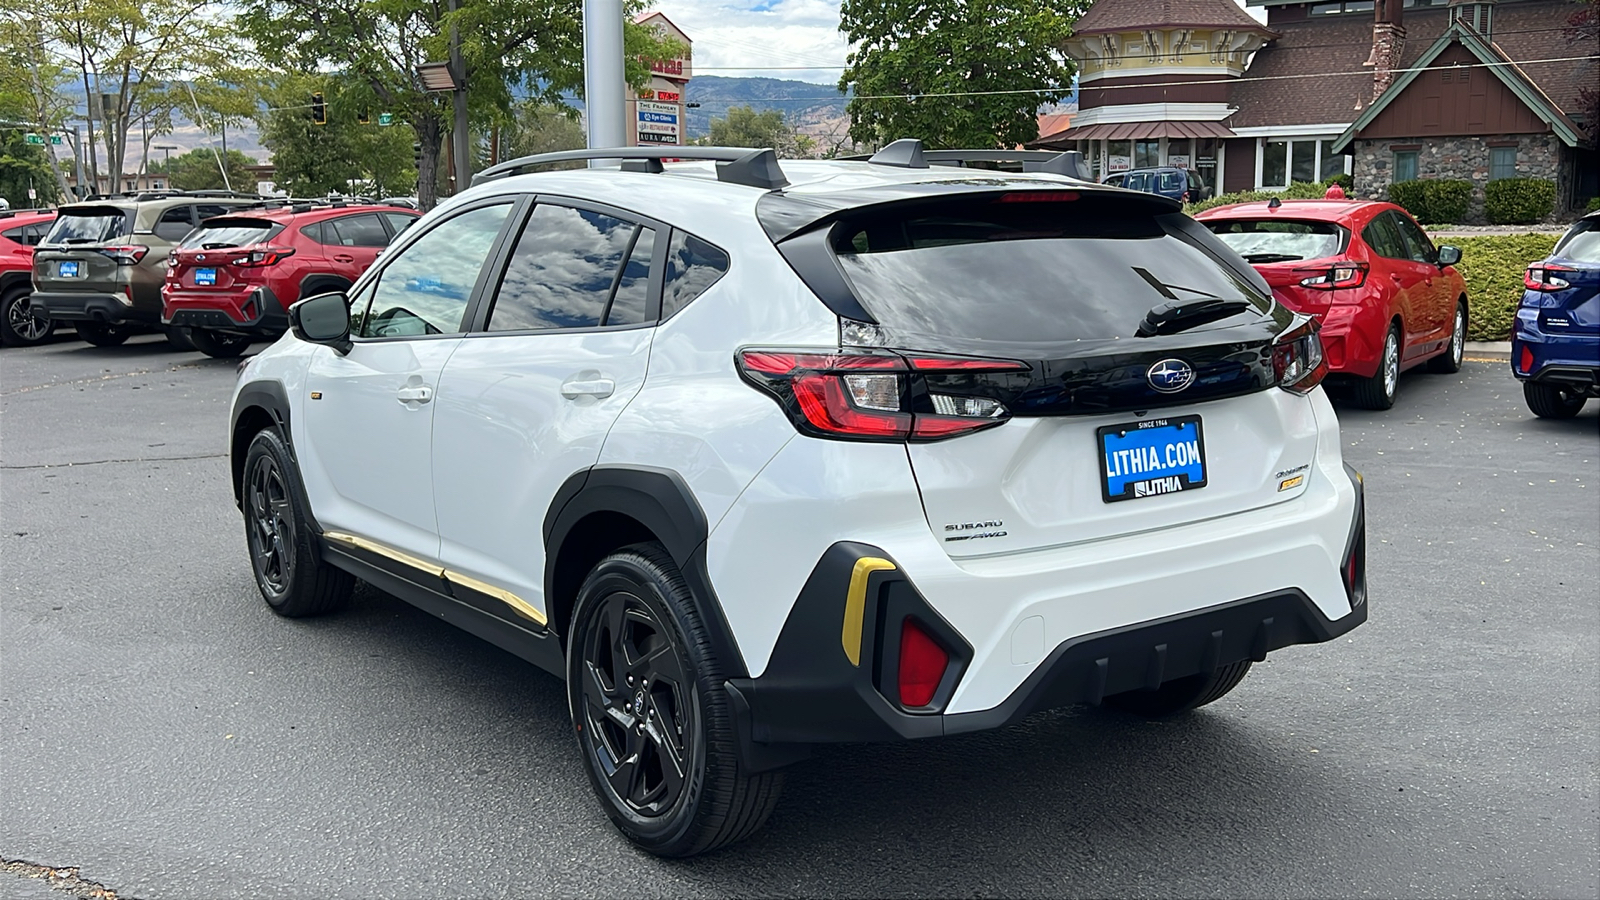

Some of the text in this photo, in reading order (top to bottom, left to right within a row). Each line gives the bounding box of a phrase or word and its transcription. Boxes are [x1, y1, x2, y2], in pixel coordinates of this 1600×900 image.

[1138, 419, 1168, 429] SINCE 1946
[1106, 440, 1201, 477] LITHIA.COM
[1145, 476, 1182, 496] LITHIA
[945, 519, 1003, 531] SUBARU
[970, 531, 1008, 540] AWD
